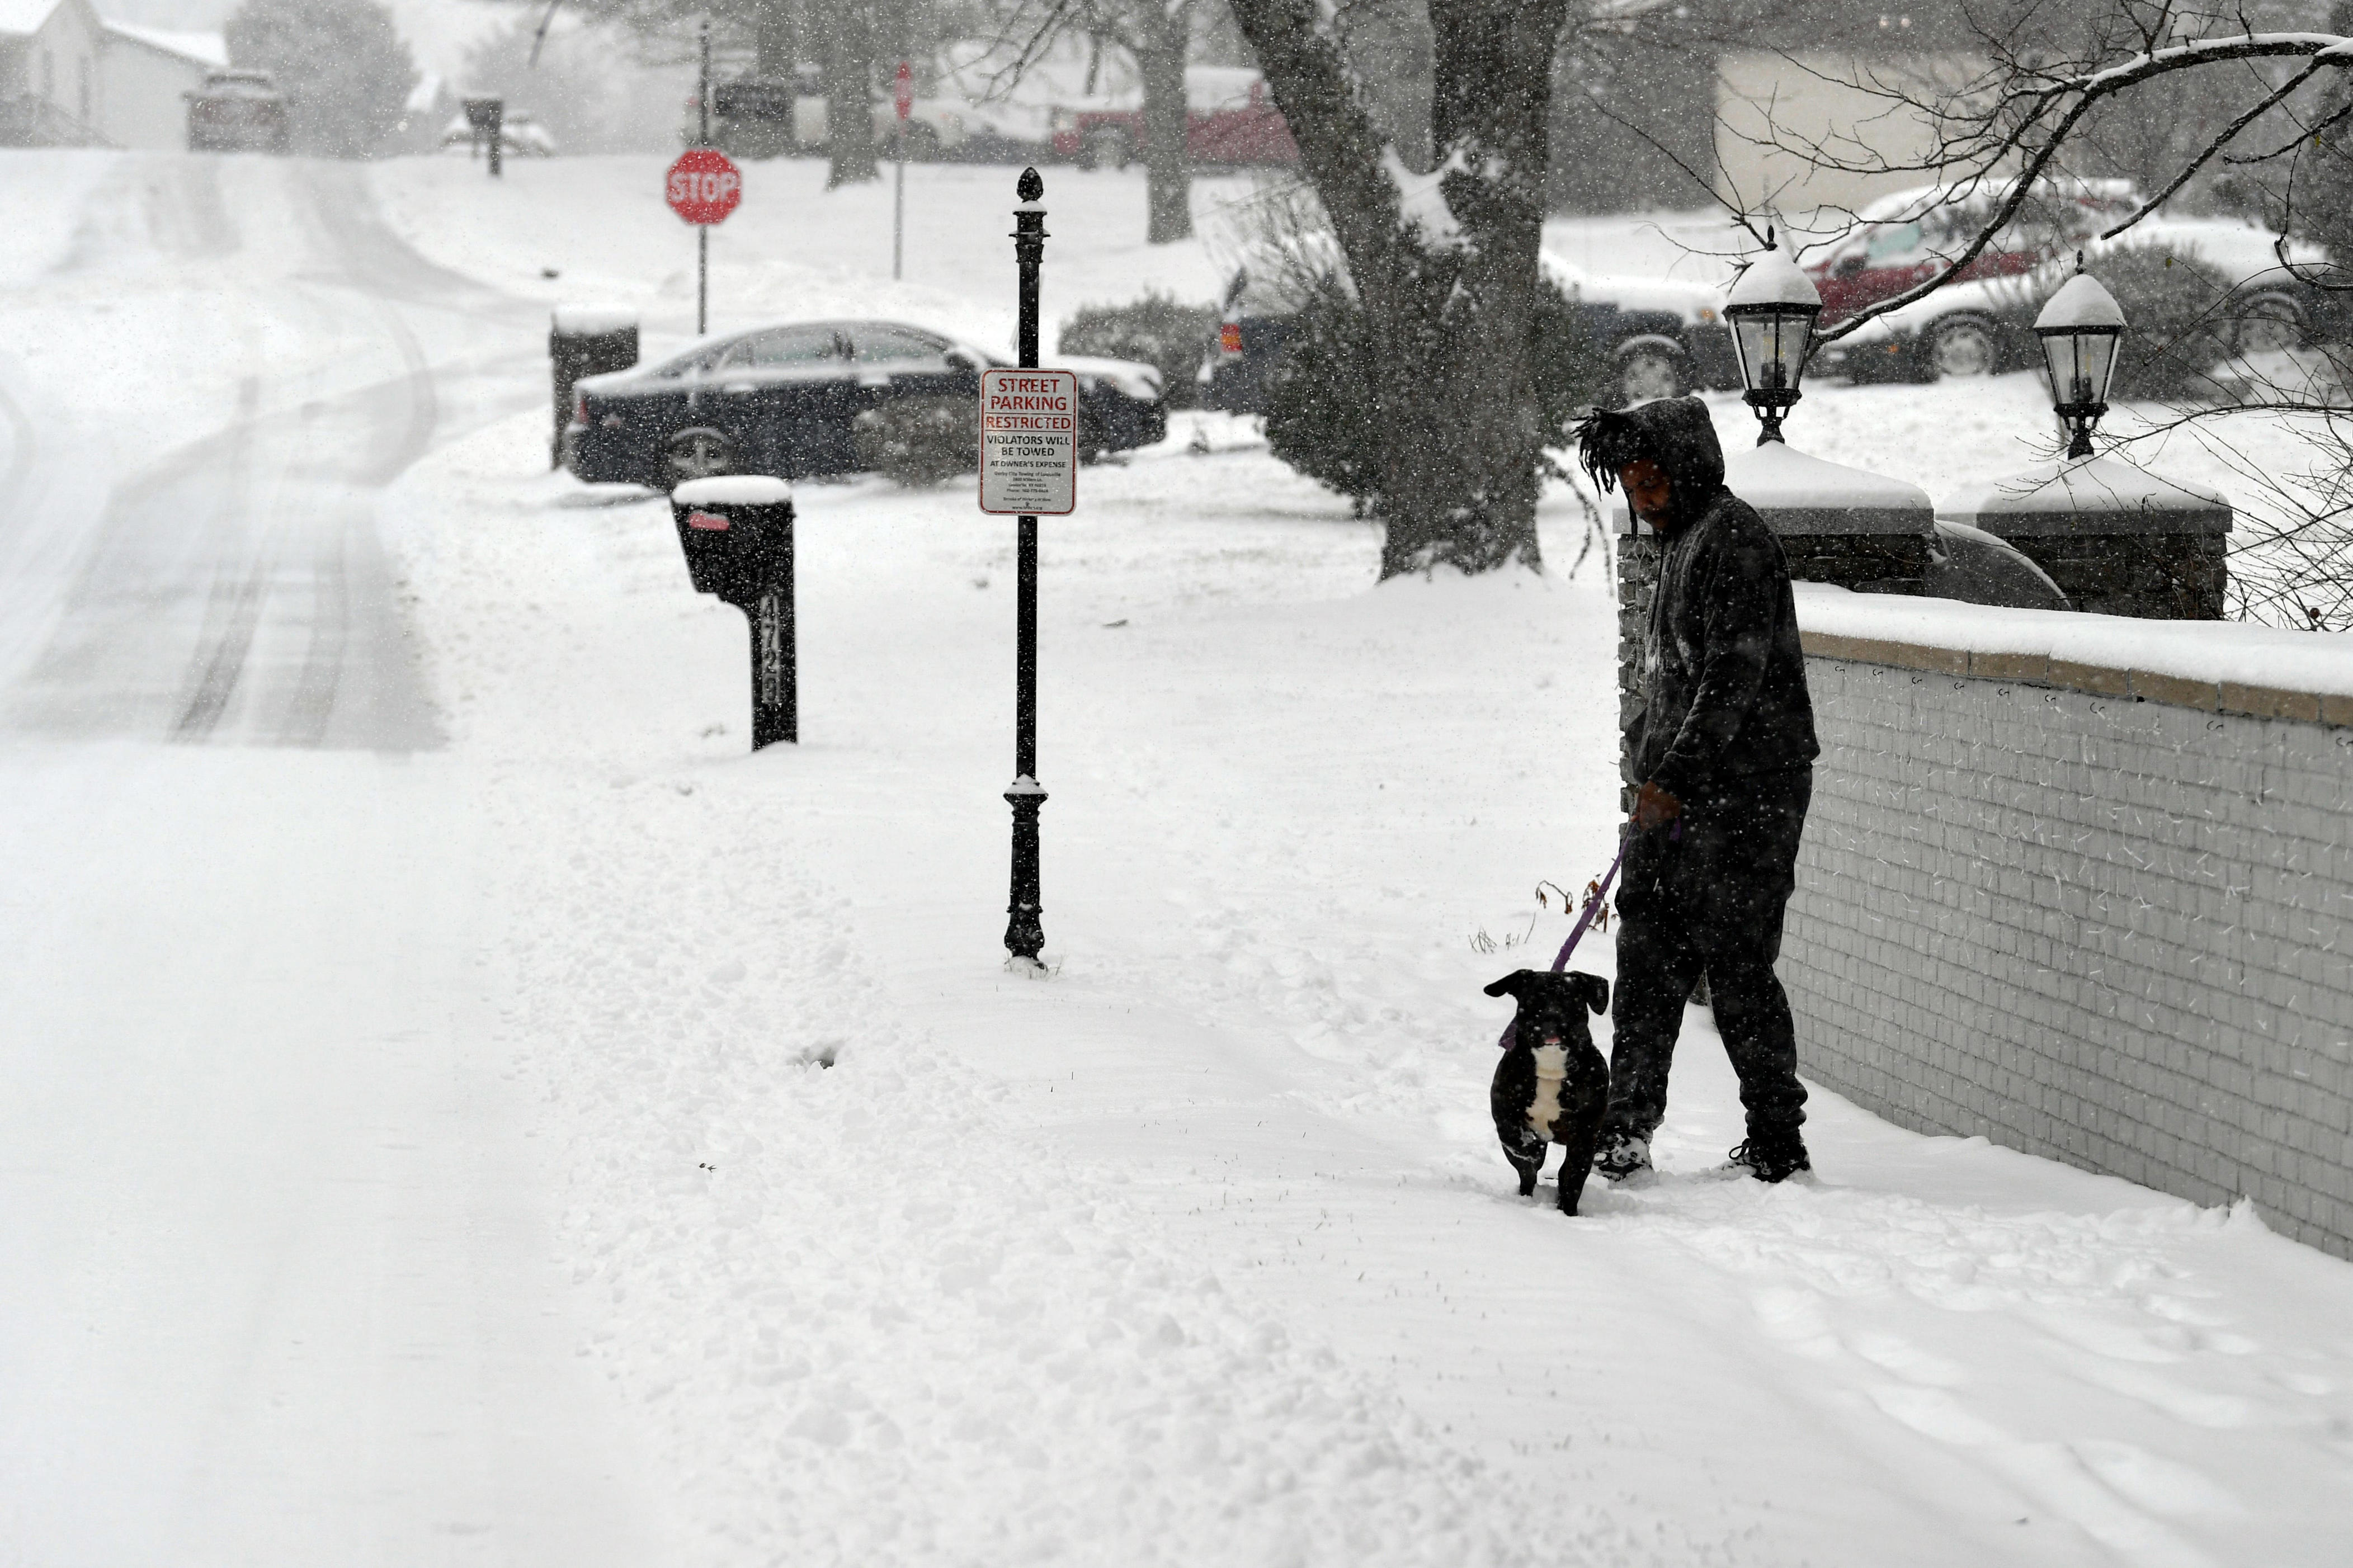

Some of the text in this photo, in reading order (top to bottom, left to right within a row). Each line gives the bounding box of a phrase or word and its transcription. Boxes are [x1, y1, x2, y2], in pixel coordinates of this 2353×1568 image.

[671, 172, 738, 202] STOP
[998, 378, 1060, 393] STREET
[991, 396, 1067, 410] PARKING
[986, 416, 1071, 429] RESTRICTED
[987, 435, 1070, 445] VIOLATORS WILL
[1002, 447, 1054, 456] BE TOWED
